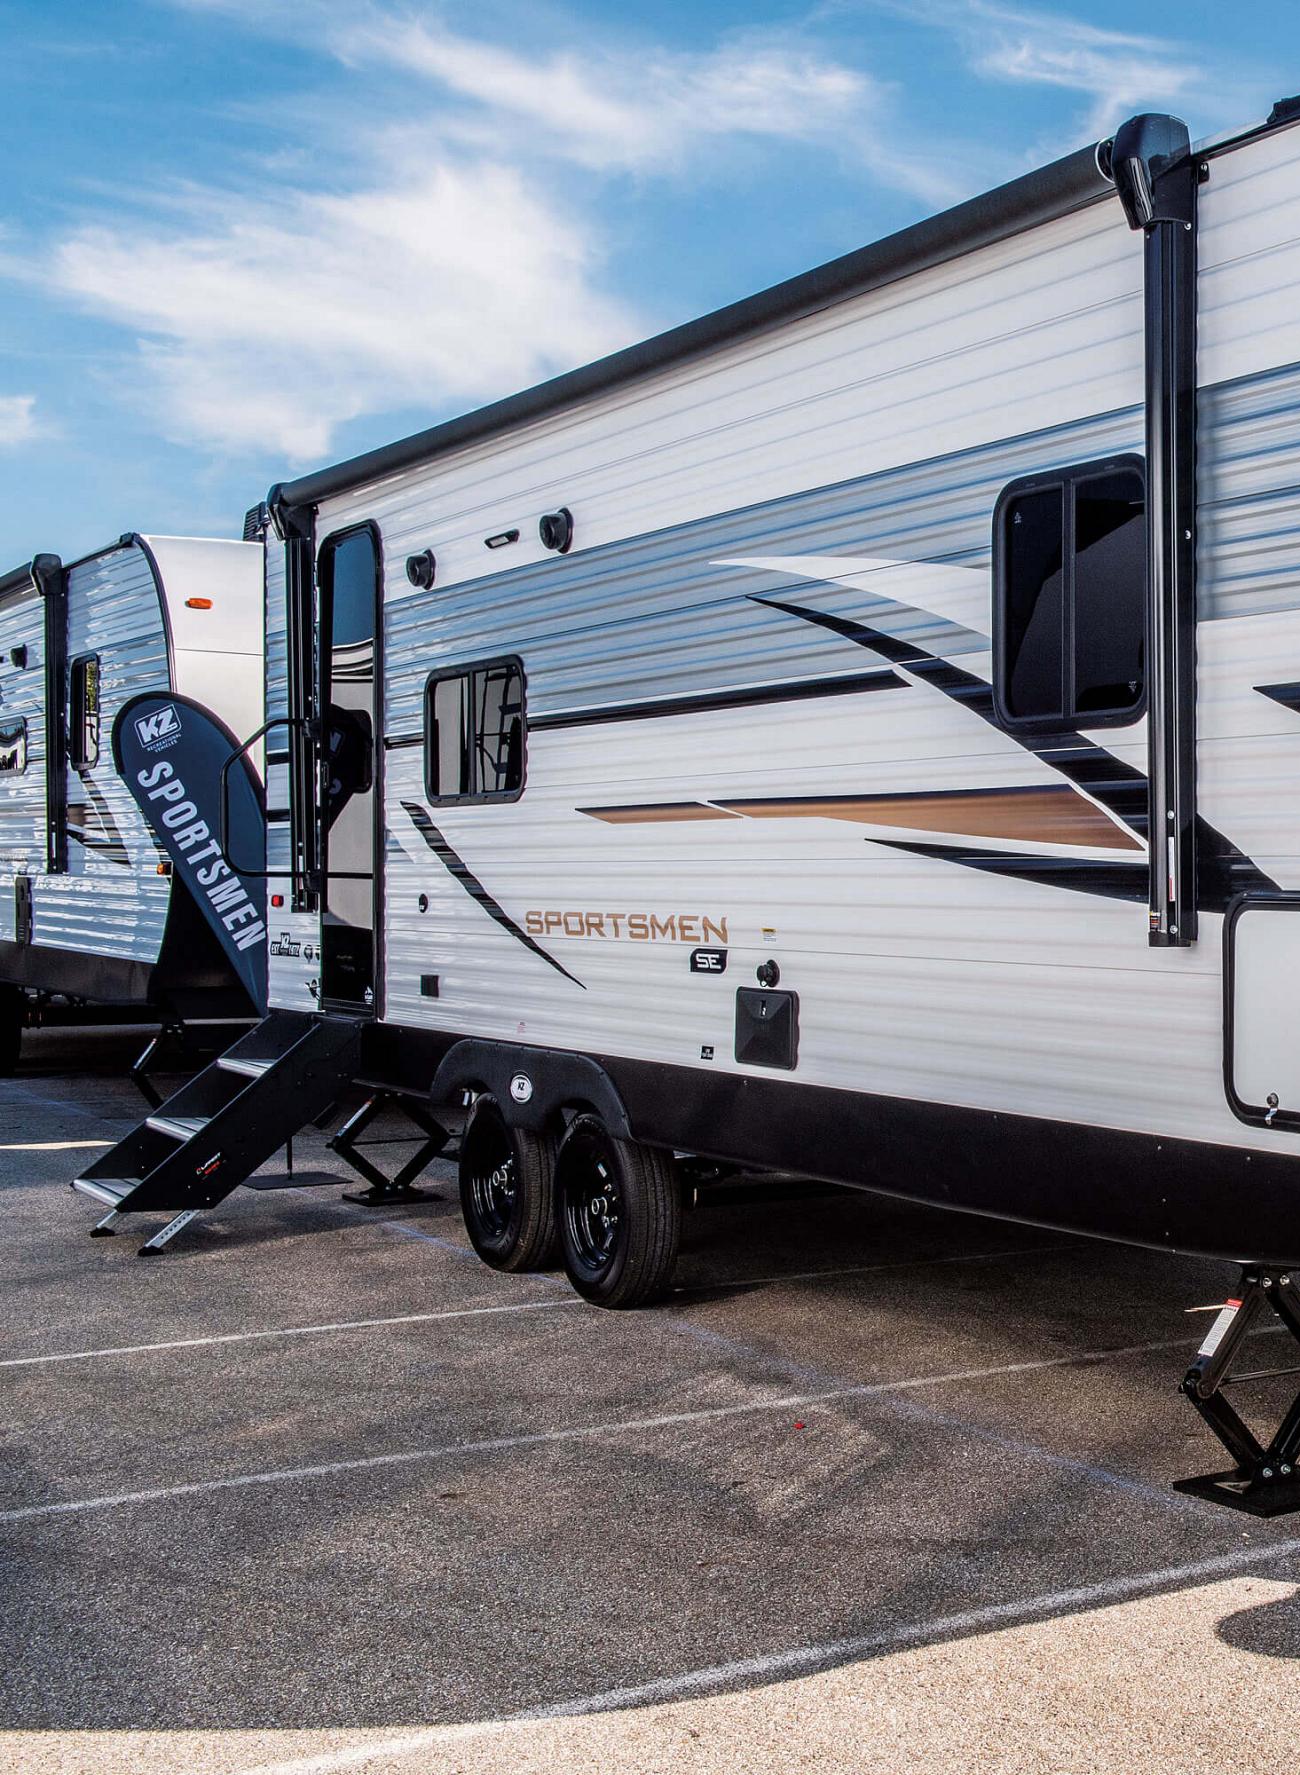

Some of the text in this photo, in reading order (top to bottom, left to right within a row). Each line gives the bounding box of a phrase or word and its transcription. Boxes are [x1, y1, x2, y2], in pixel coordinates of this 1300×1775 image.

[138, 708, 178, 743] KZ
[137, 761, 266, 951] SPORTSMEN
[525, 911, 728, 944] SPORTSMEN
[695, 953, 721, 969] SE
